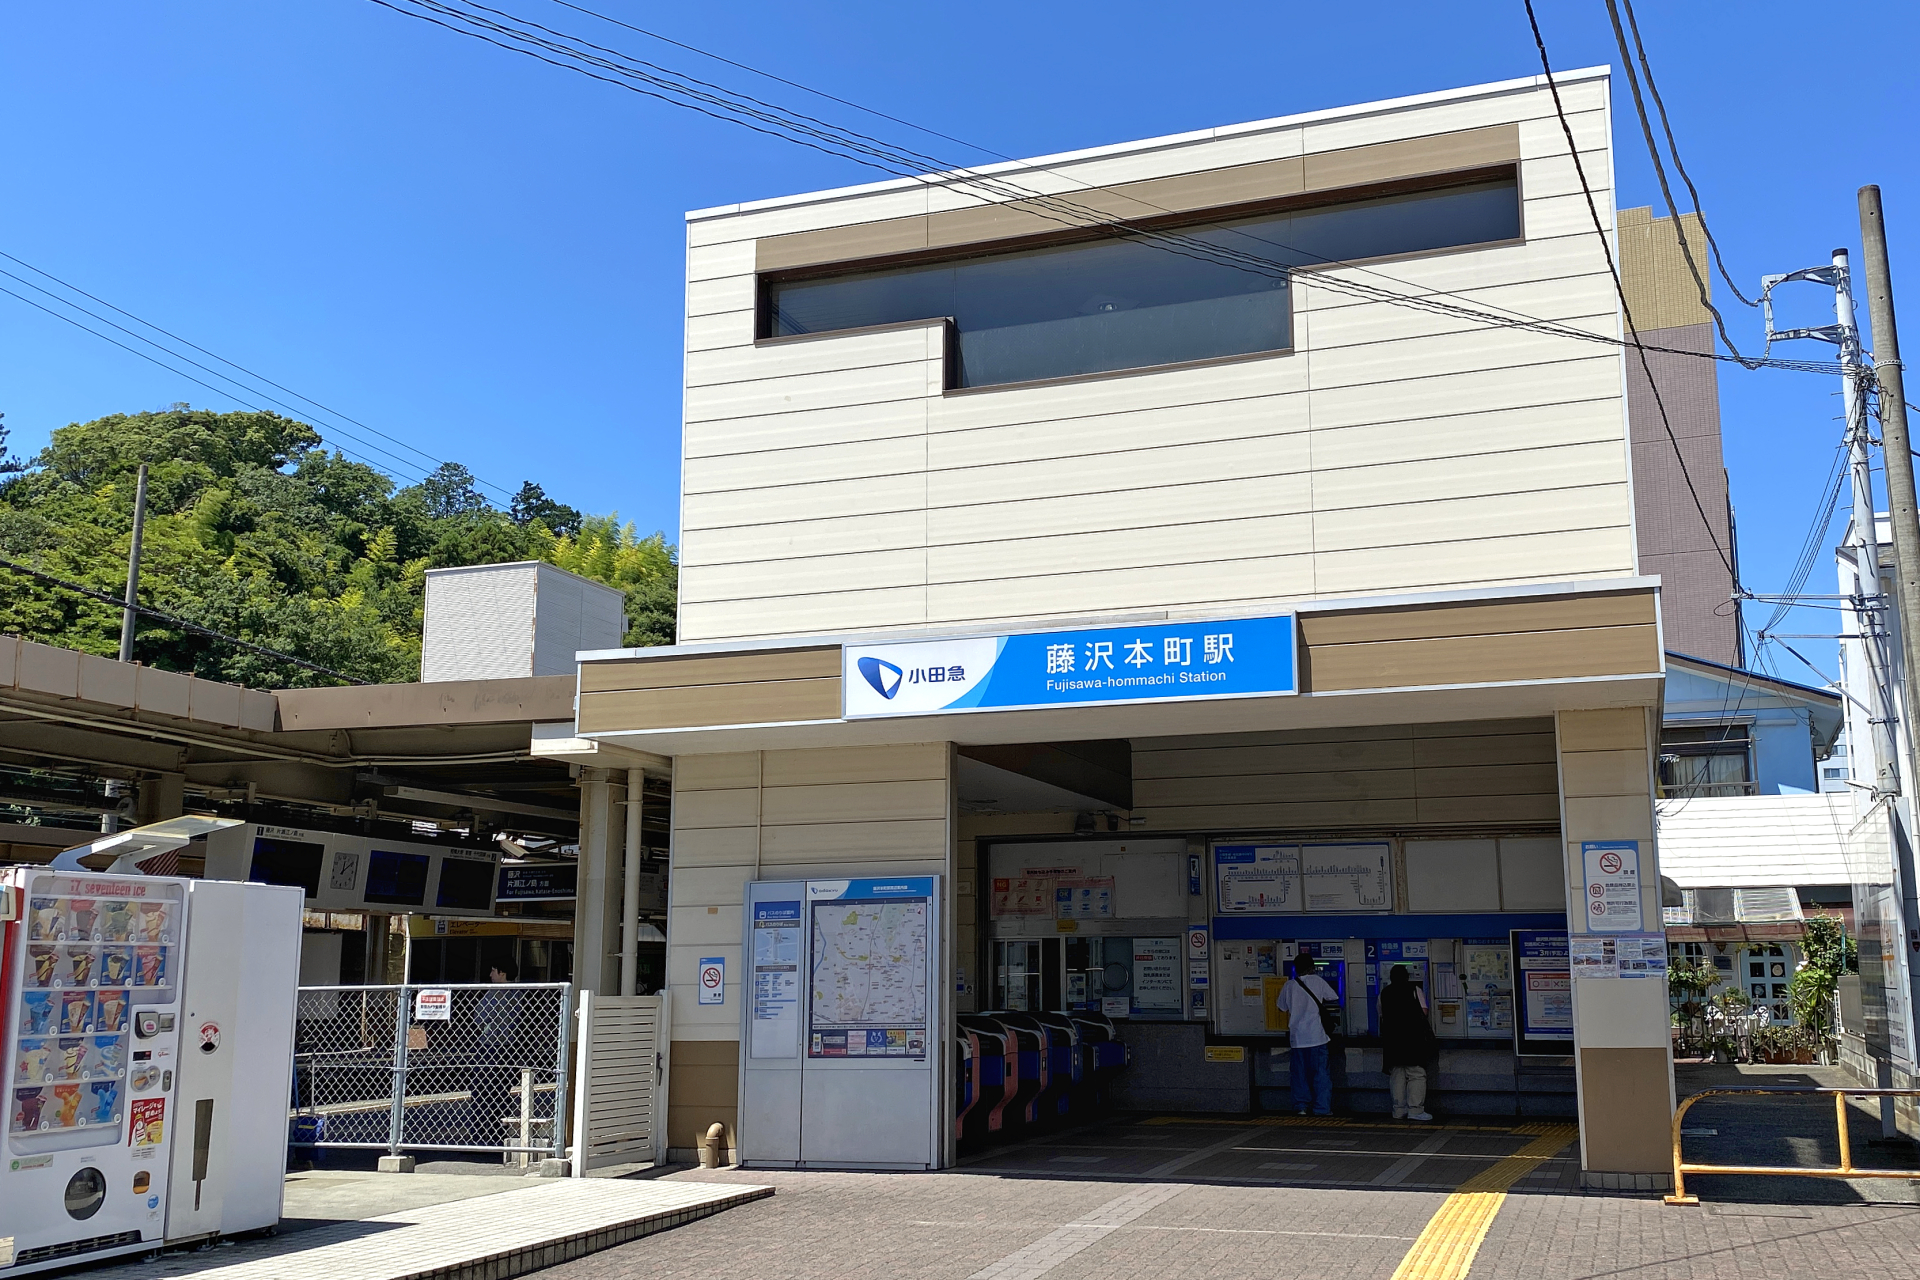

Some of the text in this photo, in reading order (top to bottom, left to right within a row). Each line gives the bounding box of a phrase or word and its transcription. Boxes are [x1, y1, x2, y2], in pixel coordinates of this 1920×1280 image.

[1046, 633, 1235, 675] 藤沢本町駅
[908, 665, 966, 684] 小田急
[1046, 670, 1227, 692] Fujisawa-hommachi Station
[84, 882, 130, 896] seventeen
[133, 882, 146, 897] ice
[507, 879, 538, 888] 片瀬江ノ島
[1285, 946, 1293, 957] 1
[1322, 945, 1343, 954] 定期券
[1367, 945, 1375, 958] 2
[1405, 945, 1425, 954] きっぷ
